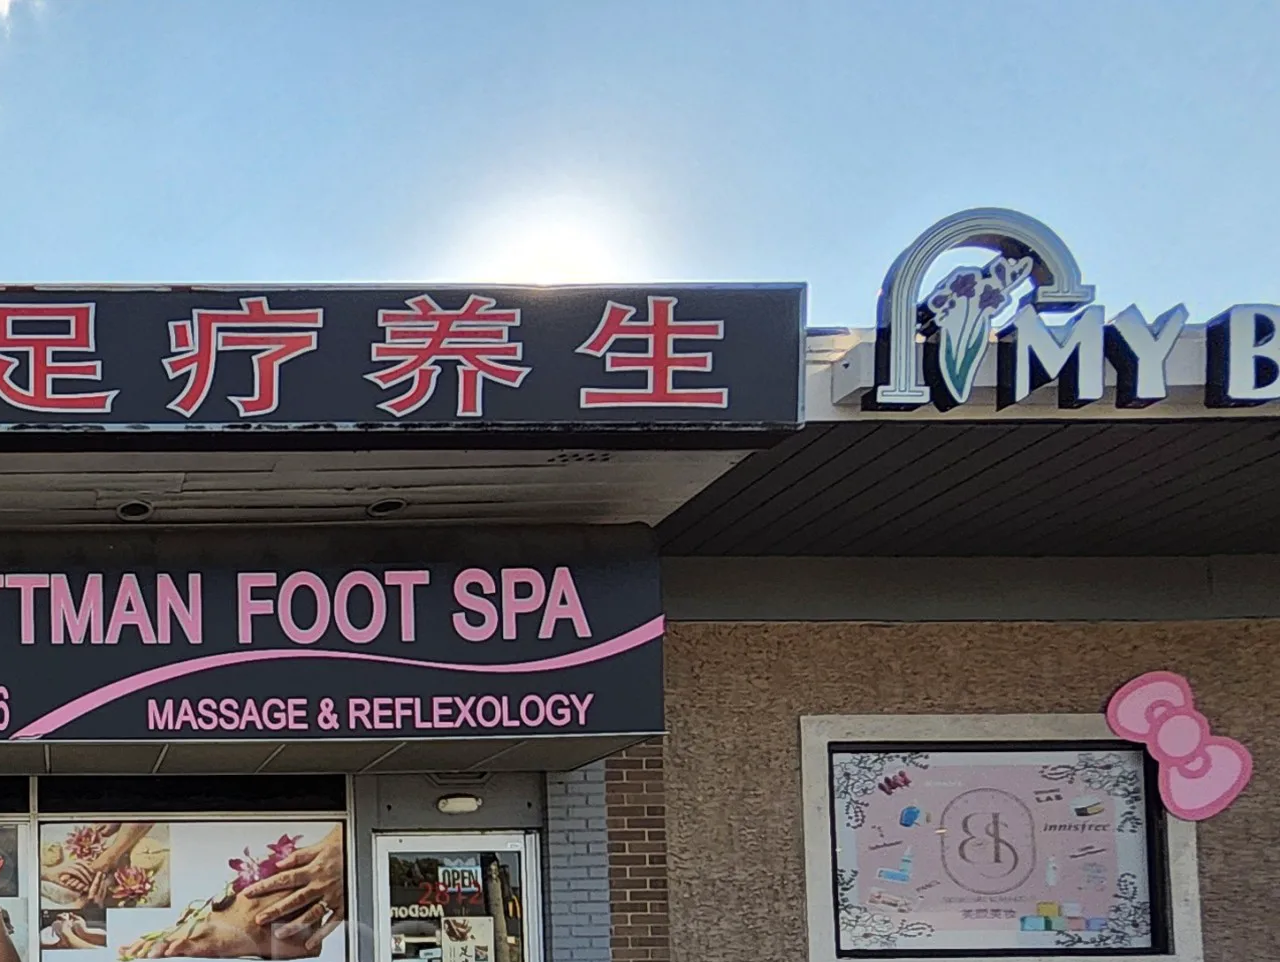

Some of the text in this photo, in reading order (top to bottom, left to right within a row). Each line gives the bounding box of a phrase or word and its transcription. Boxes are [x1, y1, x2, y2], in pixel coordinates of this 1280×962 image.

[1004, 303, 1190, 405] MY
[237, 570, 430, 644] FOOT
[452, 567, 592, 642] SPA
[148, 693, 595, 731] MASSAGE & REFLEXOLOGY
[441, 869, 478, 888] OPEN
